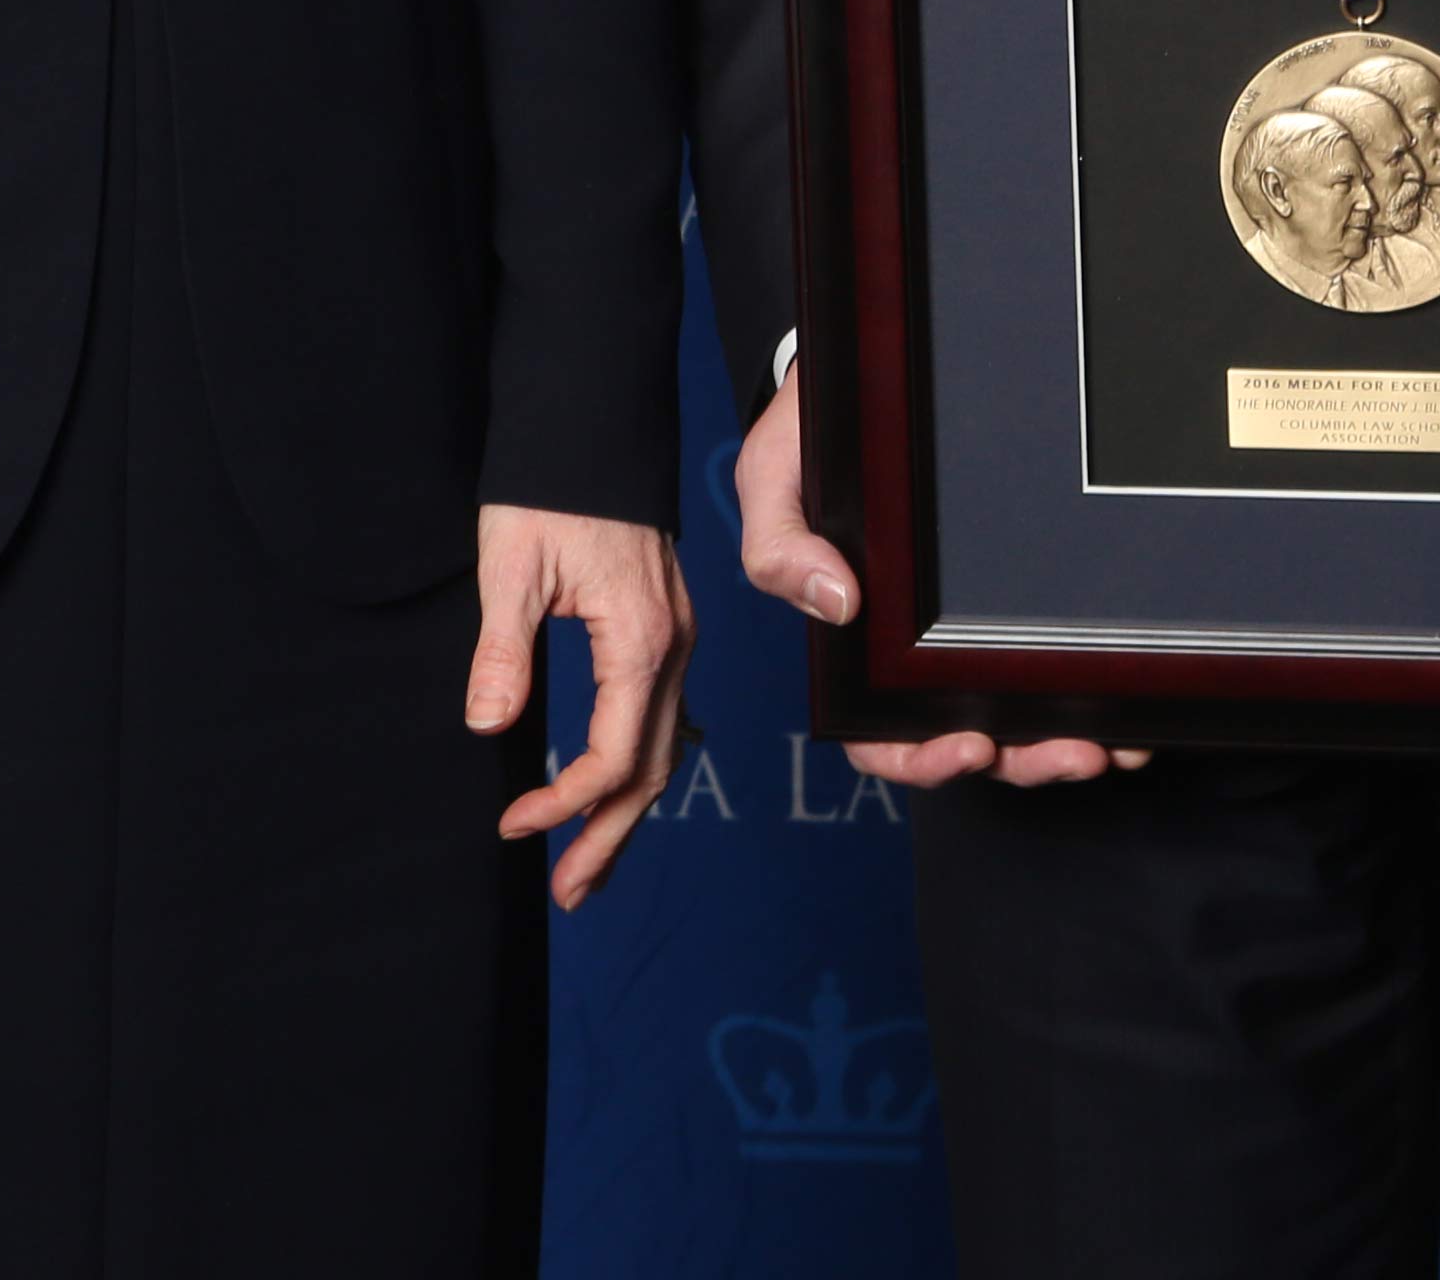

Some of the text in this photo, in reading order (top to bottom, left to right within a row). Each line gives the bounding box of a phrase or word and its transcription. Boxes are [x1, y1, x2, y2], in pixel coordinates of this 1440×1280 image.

[1243, 378, 1281, 390] 2016
[1287, 379, 1345, 391] MEDAL
[1351, 380, 1384, 391] FOR
[1236, 398, 1261, 411] THE
[1264, 399, 1346, 413] HONORABLE
[1351, 400, 1408, 414] ANTONY
[1279, 419, 1357, 431] COLUMBIA
[1362, 420, 1394, 432] LAW
[1320, 433, 1421, 445] ASSOCIATION
